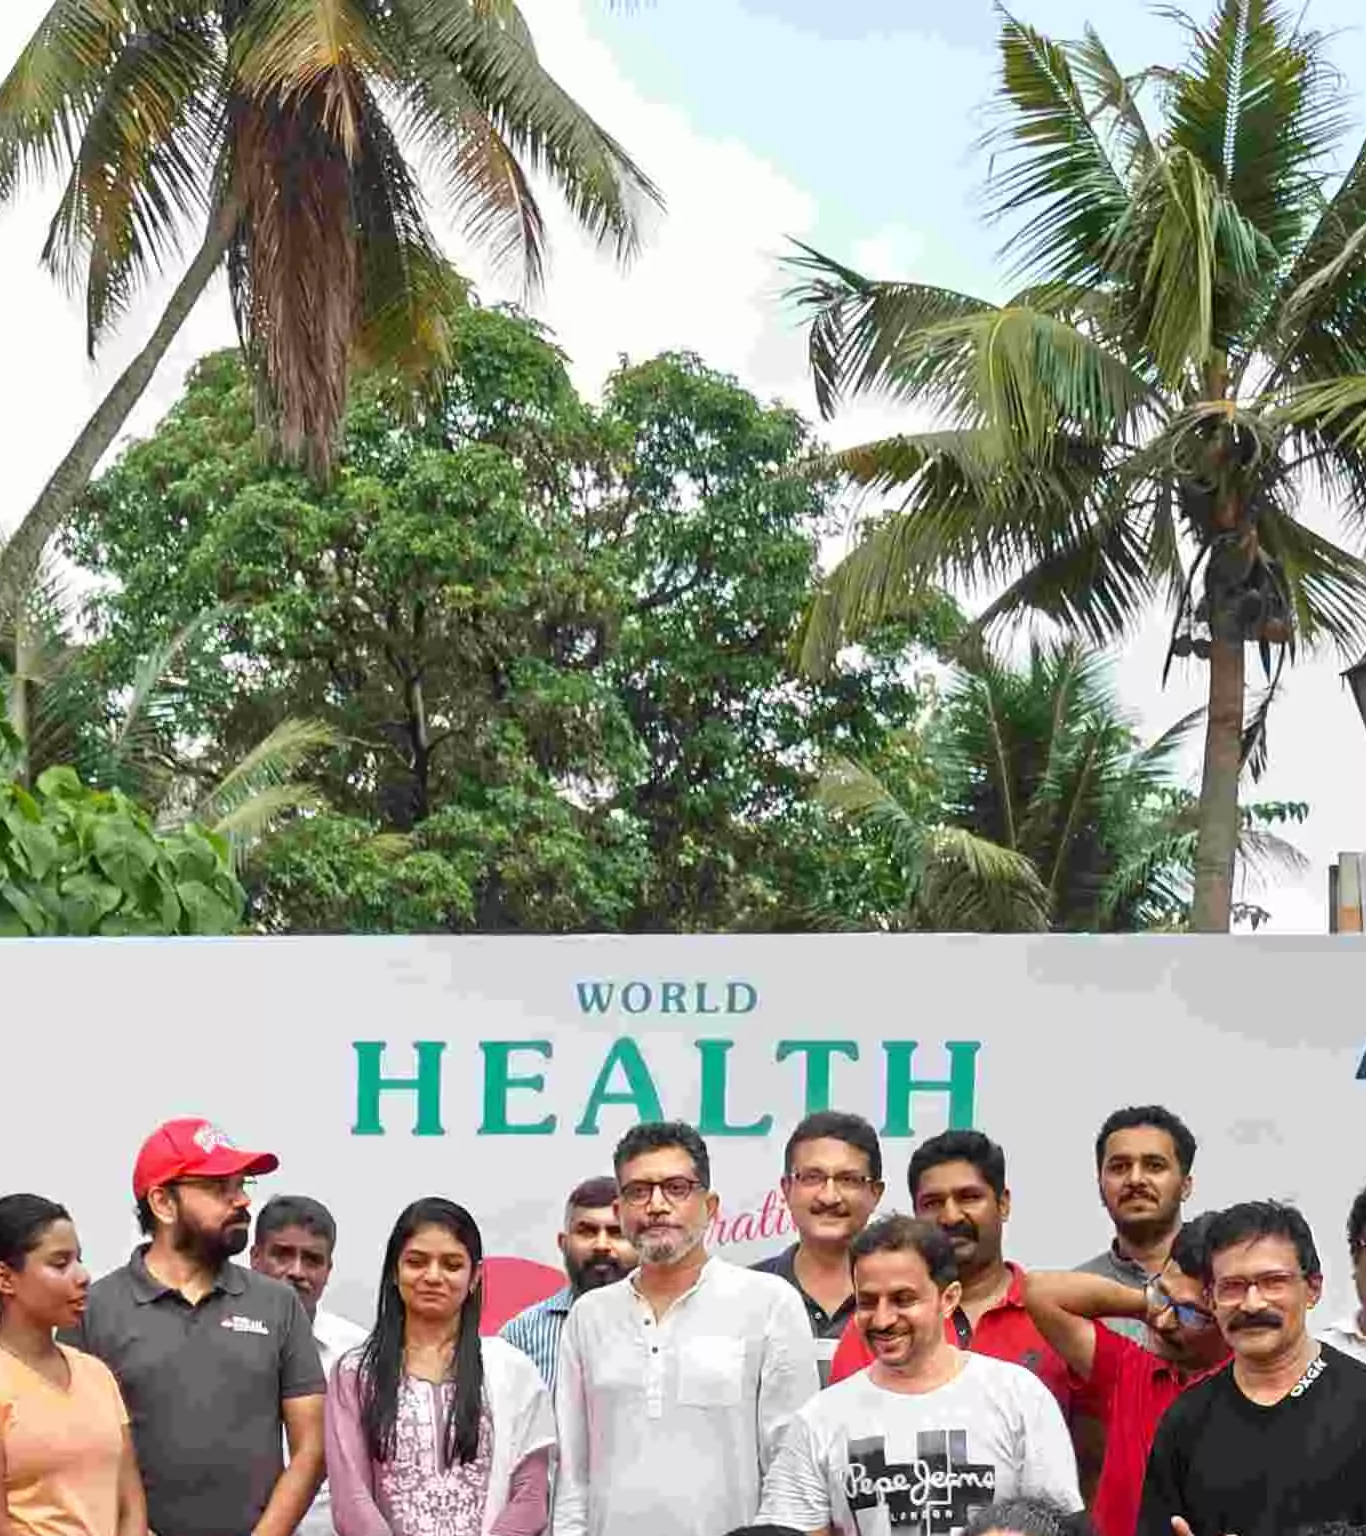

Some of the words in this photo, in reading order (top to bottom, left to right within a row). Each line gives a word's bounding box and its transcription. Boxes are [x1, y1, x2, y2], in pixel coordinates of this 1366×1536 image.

[576, 982, 758, 1014] WORLD
[350, 1036, 985, 1137] HEALTH
[839, 1463, 911, 1504] Pepe
[910, 1460, 995, 1505] Jeans
